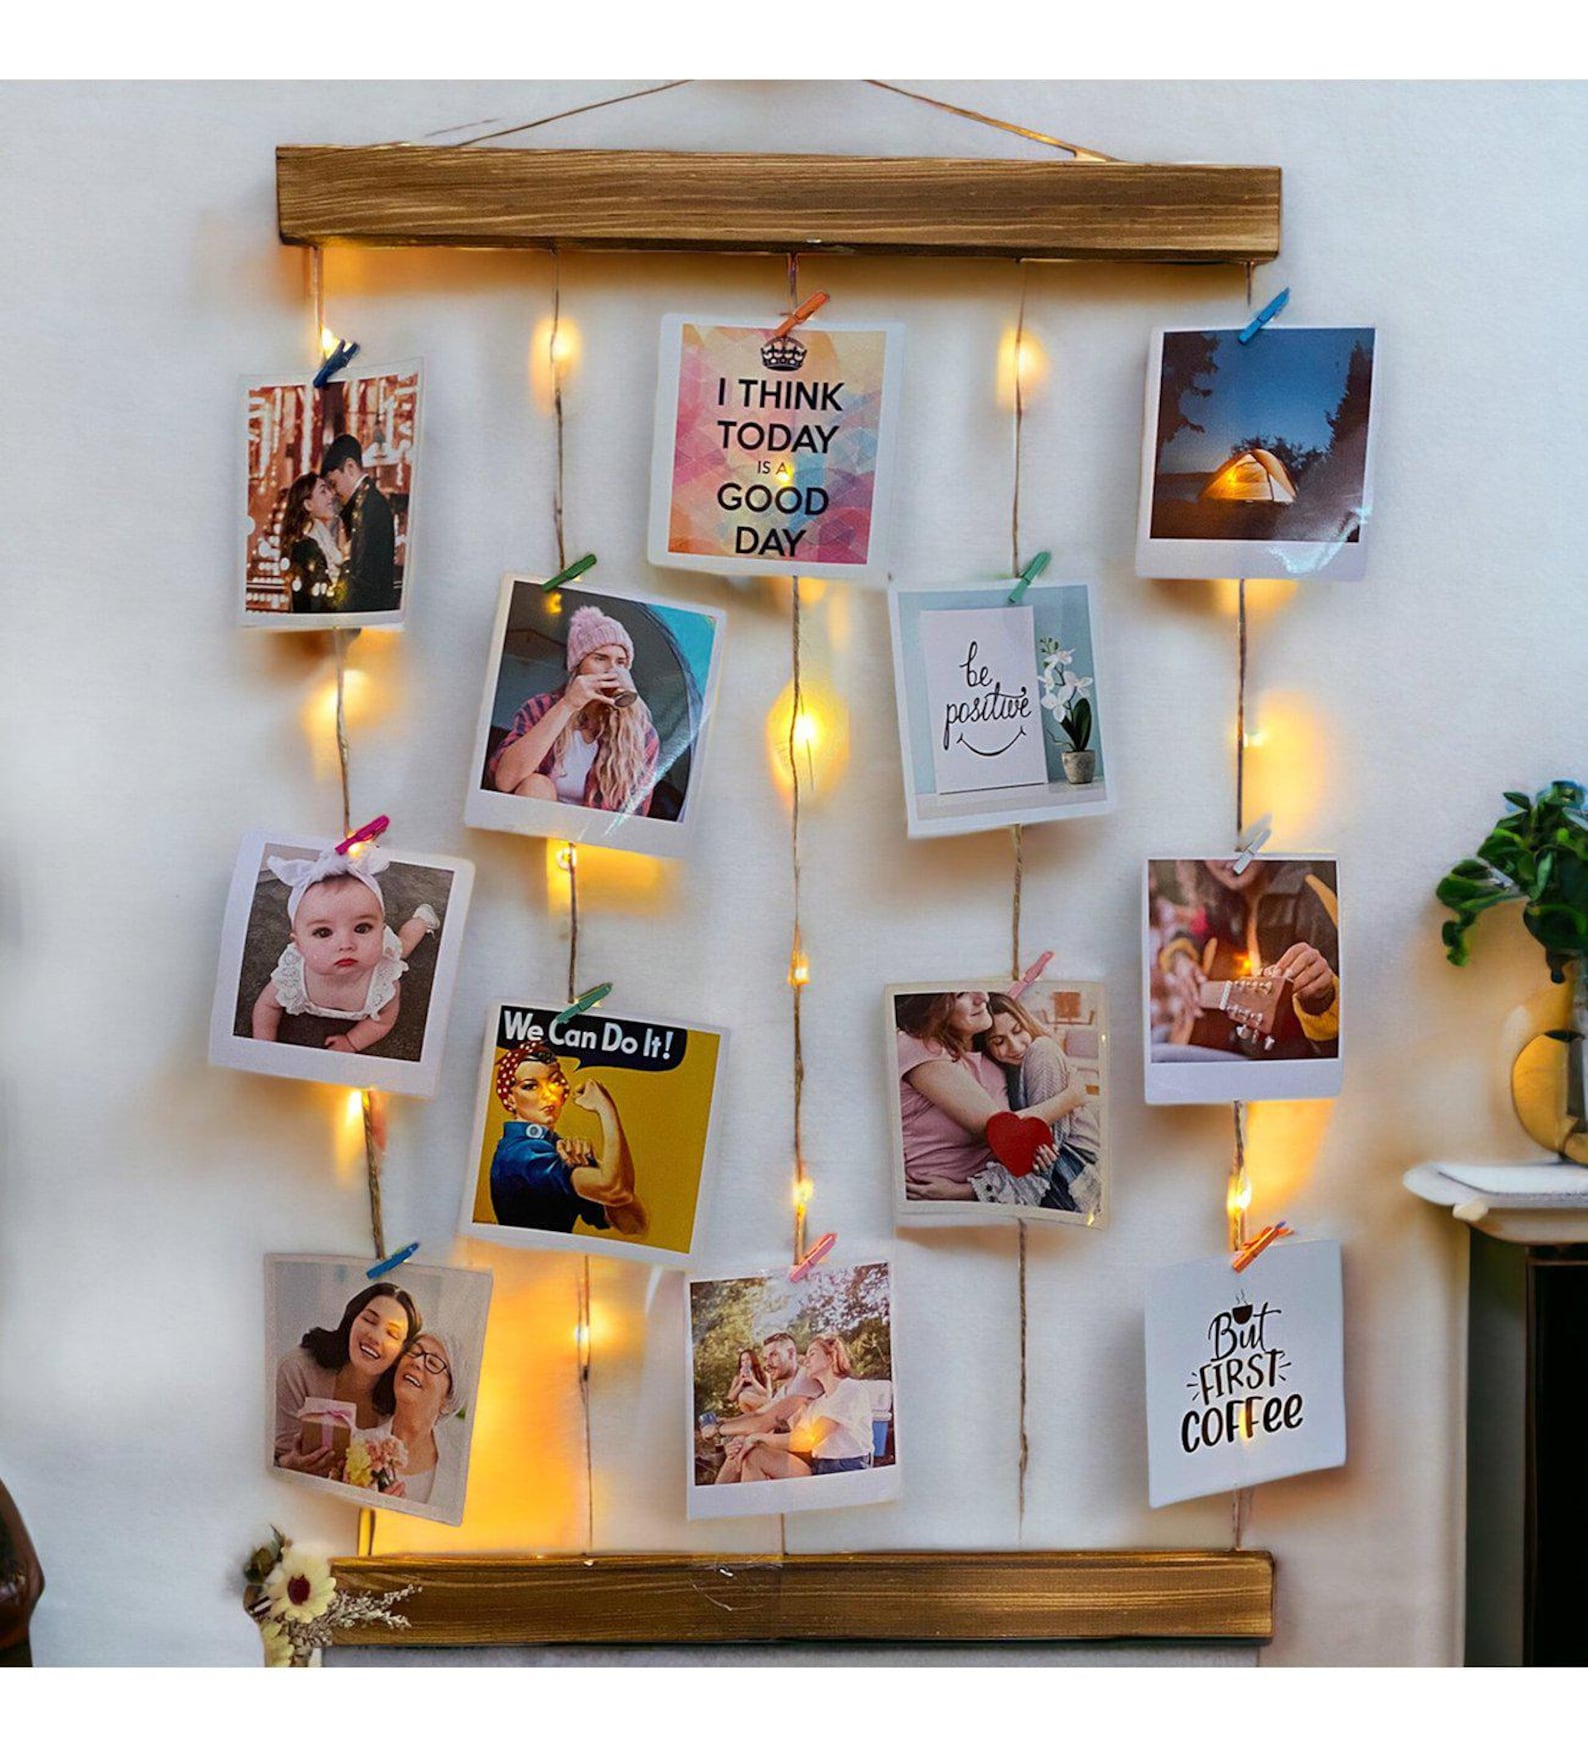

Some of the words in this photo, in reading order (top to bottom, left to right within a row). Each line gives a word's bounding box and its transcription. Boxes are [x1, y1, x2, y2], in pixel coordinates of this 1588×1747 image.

[717, 377, 726, 406] I
[738, 378, 845, 411] THINK
[717, 420, 840, 454] TODAY
[757, 460, 771, 475] IS
[775, 461, 789, 475] A
[717, 482, 829, 516] GOOD
[735, 526, 807, 557] DAY
[959, 641, 993, 687] be
[943, 682, 1032, 750] positive
[504, 1010, 544, 1041] We
[549, 1018, 597, 1050] Can
[602, 1022, 638, 1055] Do
[643, 1028, 674, 1060] It!
[1208, 1302, 1282, 1362] But
[1199, 1349, 1284, 1406] FIRST
